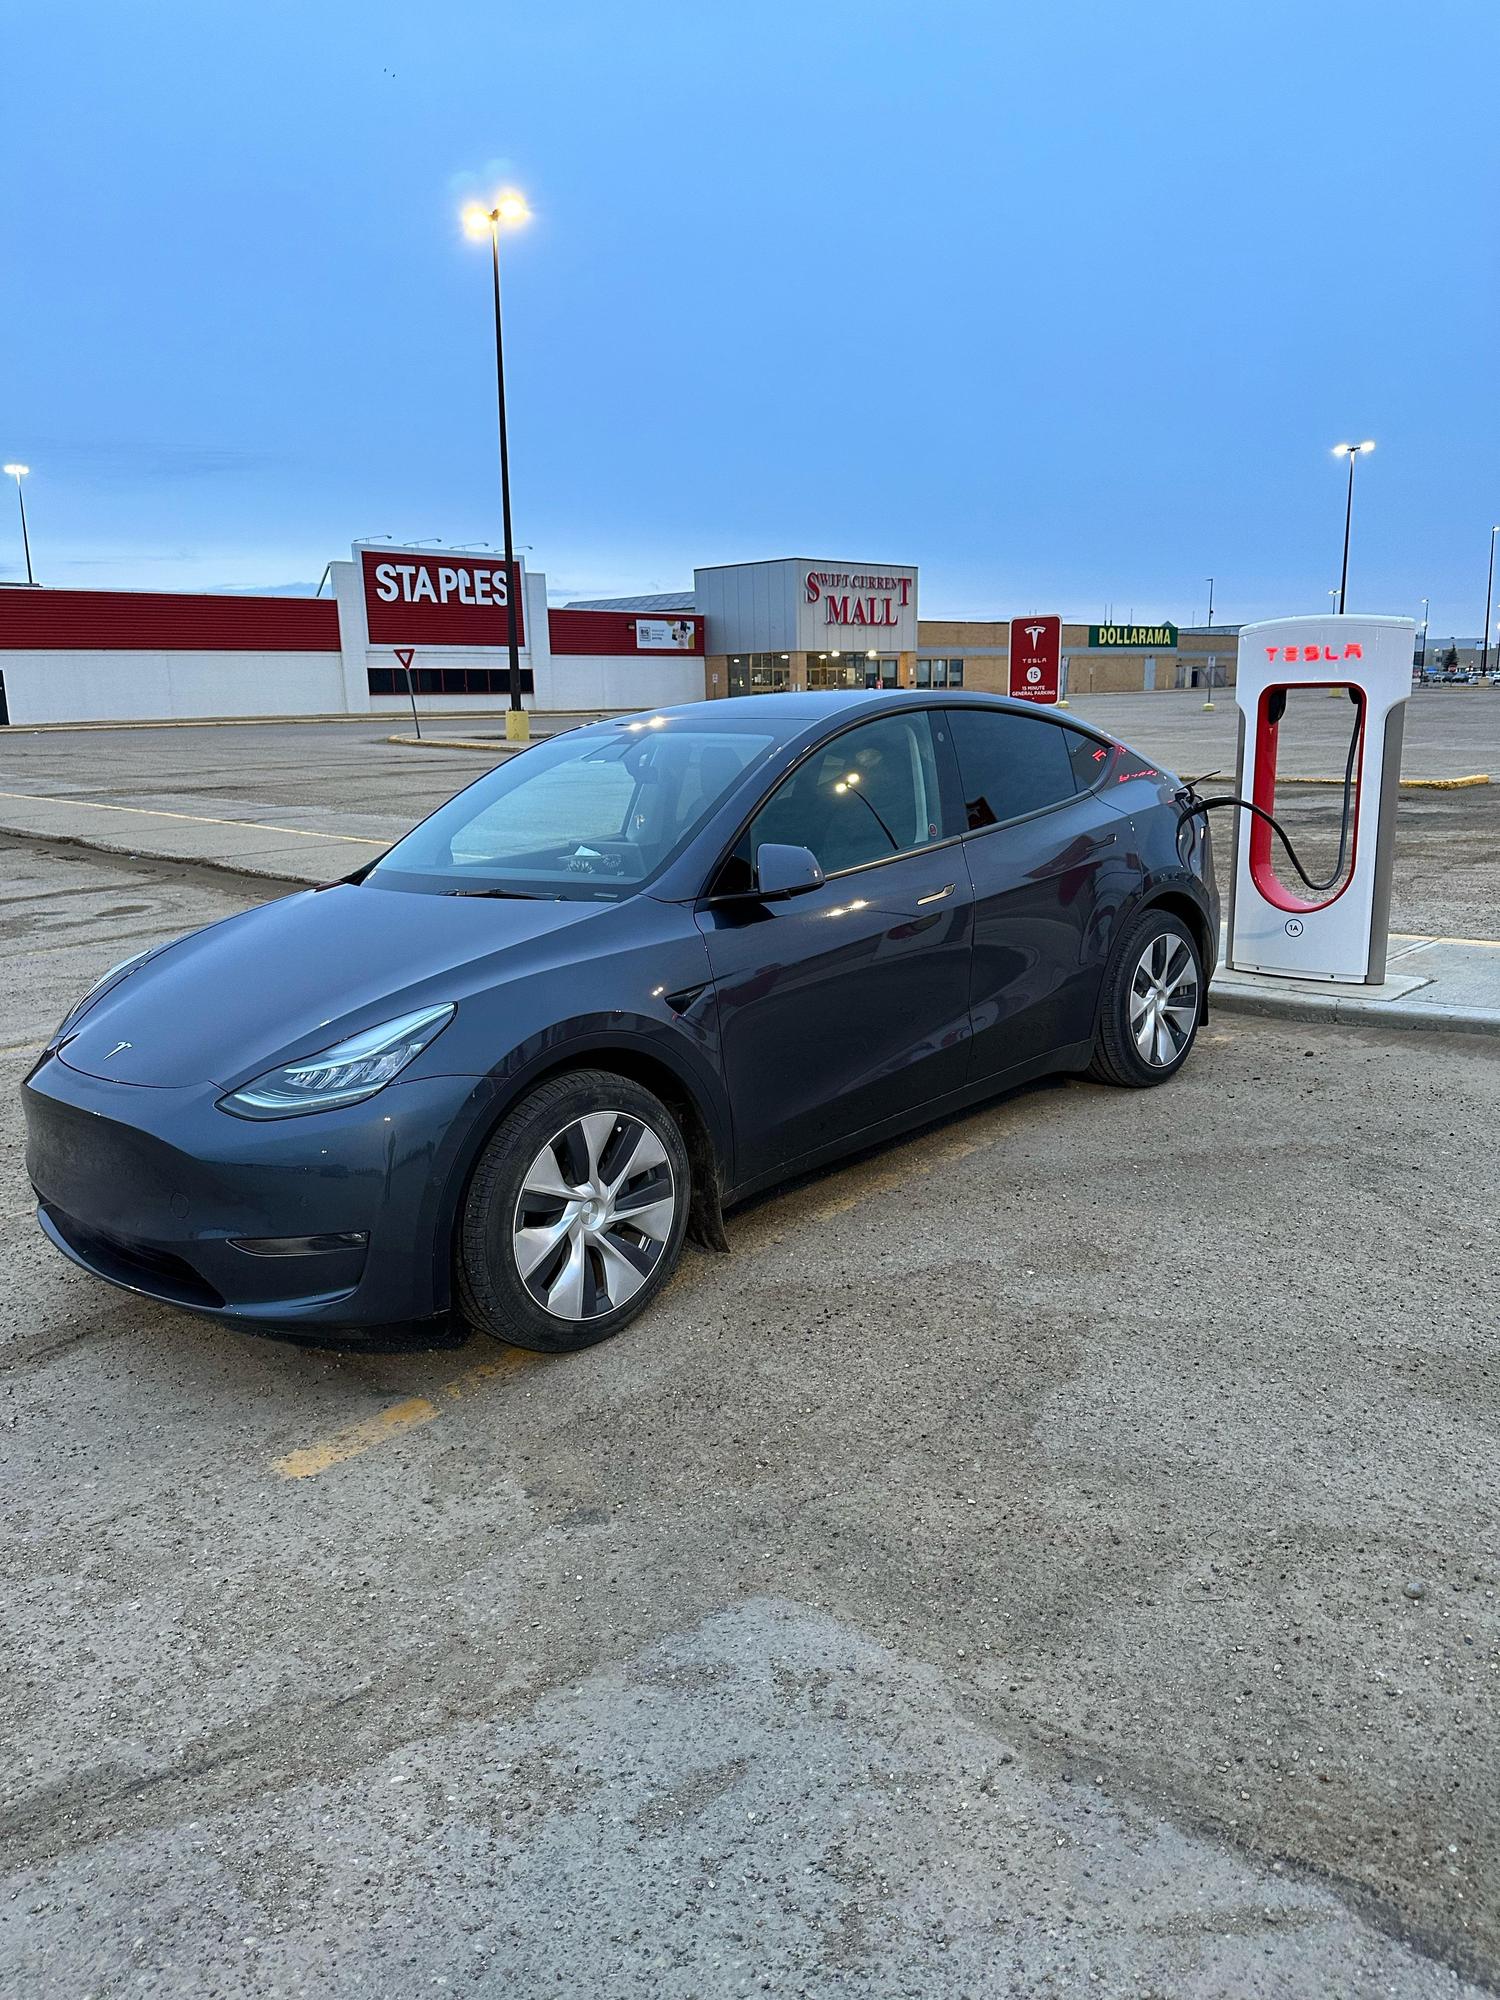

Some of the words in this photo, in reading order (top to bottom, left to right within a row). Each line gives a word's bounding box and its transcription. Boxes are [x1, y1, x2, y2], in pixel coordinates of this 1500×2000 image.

[375, 563, 508, 606] STAPLES
[805, 571, 850, 604] SWIFT
[850, 574, 912, 607] CURRENT
[824, 595, 899, 626] MALL
[1098, 627, 1171, 645] DOLLARAMA
[1264, 643, 1364, 664] TESLA
[1030, 671, 1039, 679] 15
[1290, 924, 1299, 932] 1A
